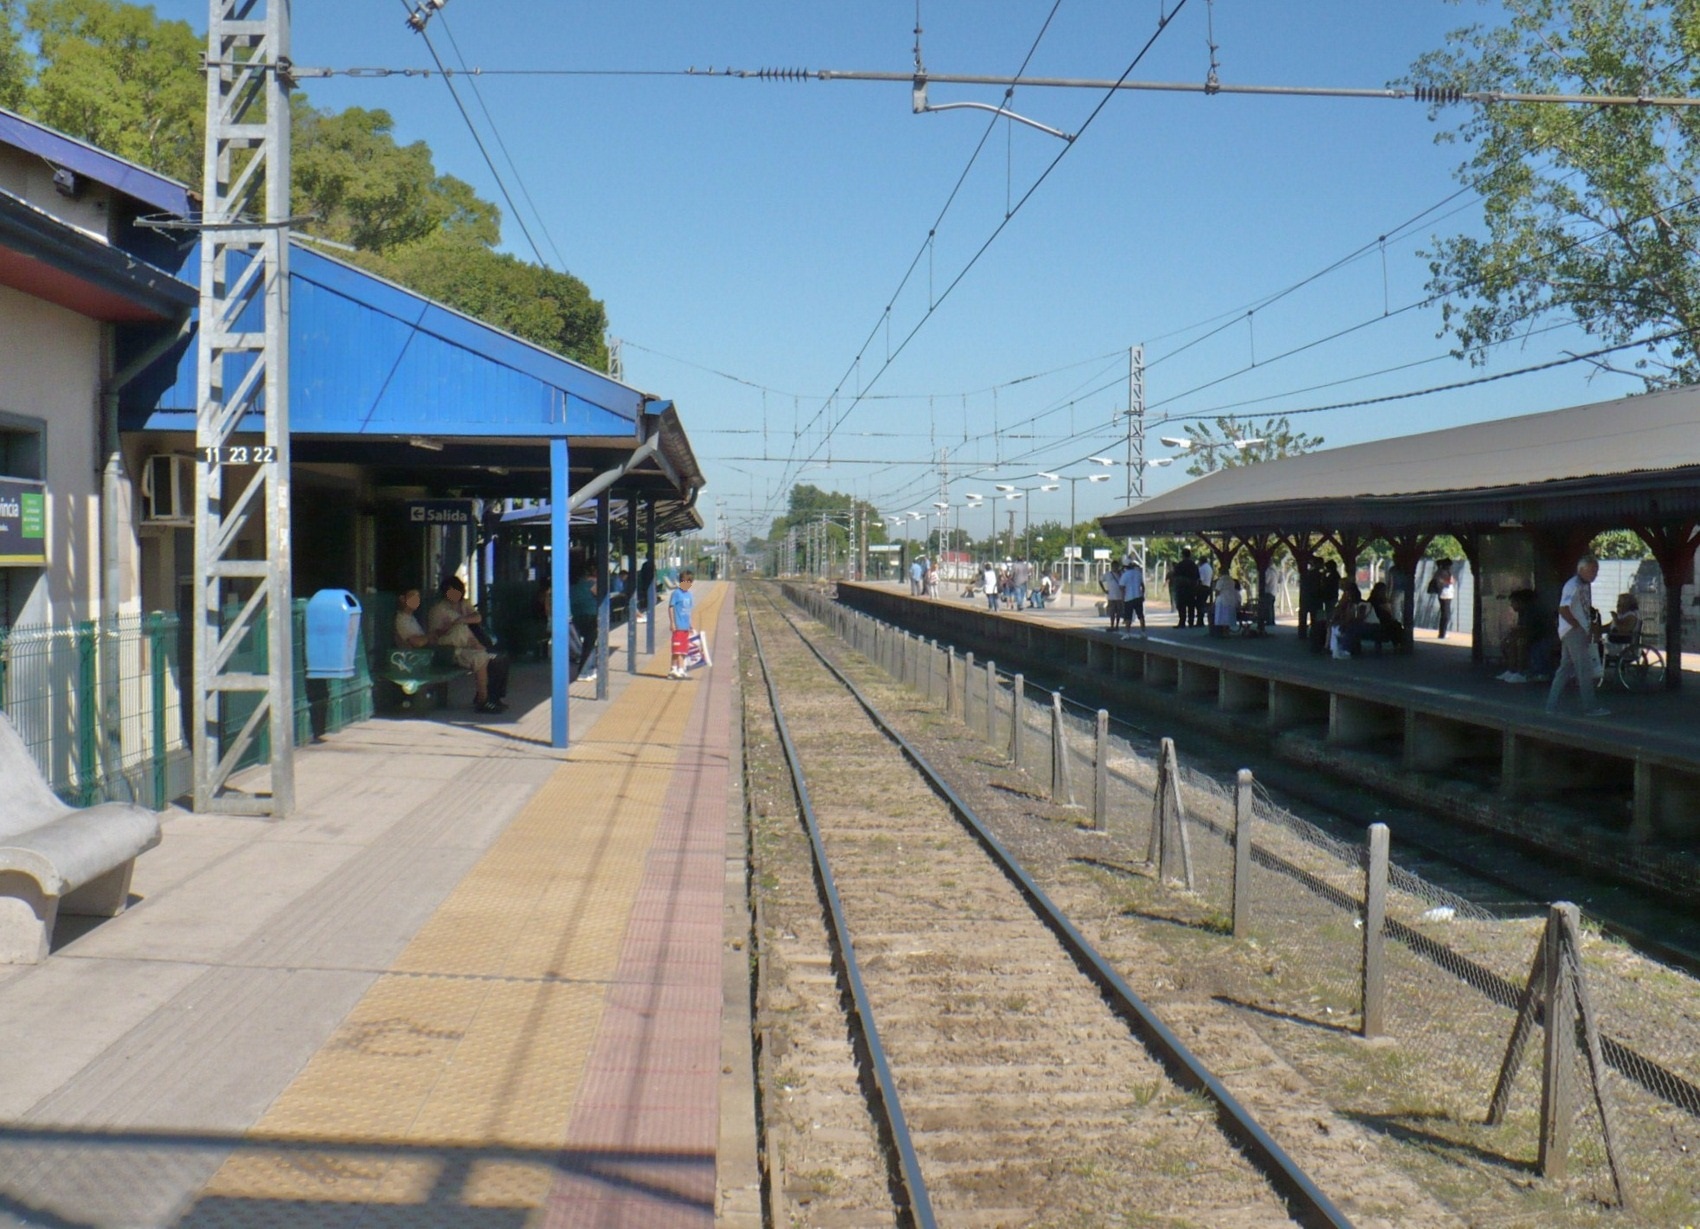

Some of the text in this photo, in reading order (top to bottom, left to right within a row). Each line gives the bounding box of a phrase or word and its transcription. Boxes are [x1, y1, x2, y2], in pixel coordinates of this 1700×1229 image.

[205, 447, 273, 462] 11 23 22
[427, 509, 468, 521] Salida
